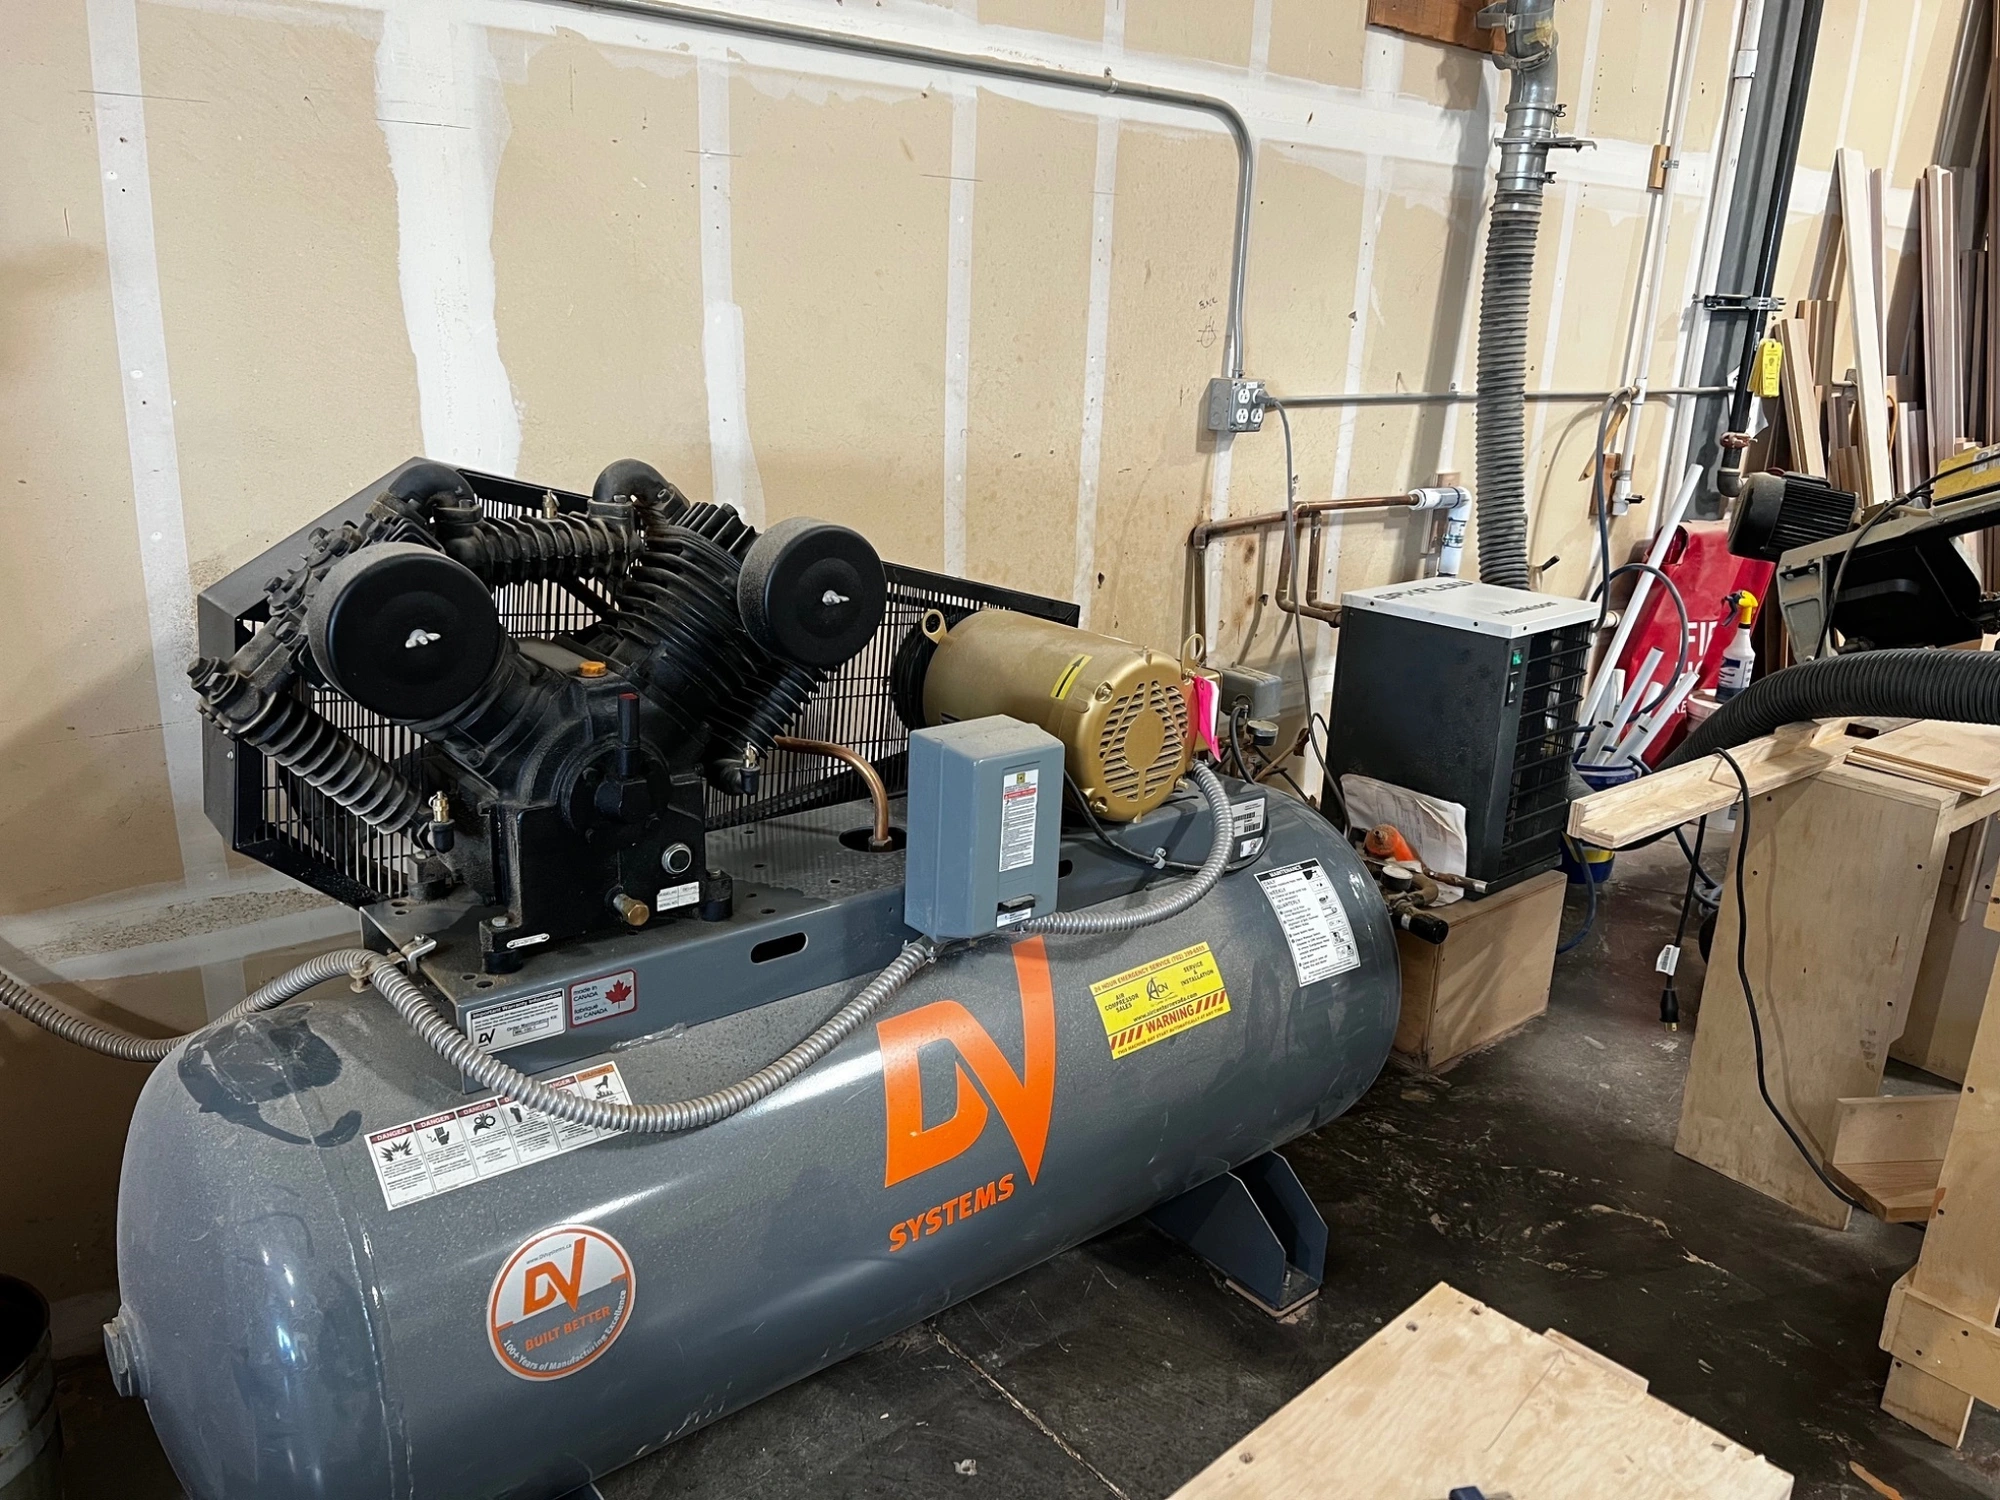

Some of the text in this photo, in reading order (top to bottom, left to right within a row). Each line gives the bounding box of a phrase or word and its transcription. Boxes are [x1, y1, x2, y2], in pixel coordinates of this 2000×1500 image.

[1102, 980, 1118, 991] HOUR
[1118, 967, 1149, 983] EMERGENCY
[1149, 958, 1171, 972] SERVICE
[1183, 961, 1203, 973] SERVICE
[1181, 969, 1214, 986] INSTALLATION
[573, 987, 591, 995] made
[573, 991, 598, 1001] CANADA
[1116, 993, 1125, 1001] AIR
[472, 992, 561, 1018] Important Warranty Information
[1104, 993, 1139, 1011] COMPRESSOR
[1116, 1003, 1132, 1013] SALES
[583, 1008, 608, 1018] CANADA
[1145, 1004, 1195, 1034] WARNING
[876, 935, 1056, 1188] DV
[581, 1065, 611, 1080] WARNING
[549, 1077, 571, 1090] ANGER
[462, 1102, 492, 1116] DANGER
[420, 1114, 450, 1129] DANGER
[377, 1127, 408, 1142] DANGER
[889, 1173, 1015, 1252] SYSTEMS
[523, 1236, 587, 1316] DV
[503, 1290, 627, 1371] 100+ Years of Manufacturing Excellence
[525, 1306, 612, 1351] BUILT BETTER
